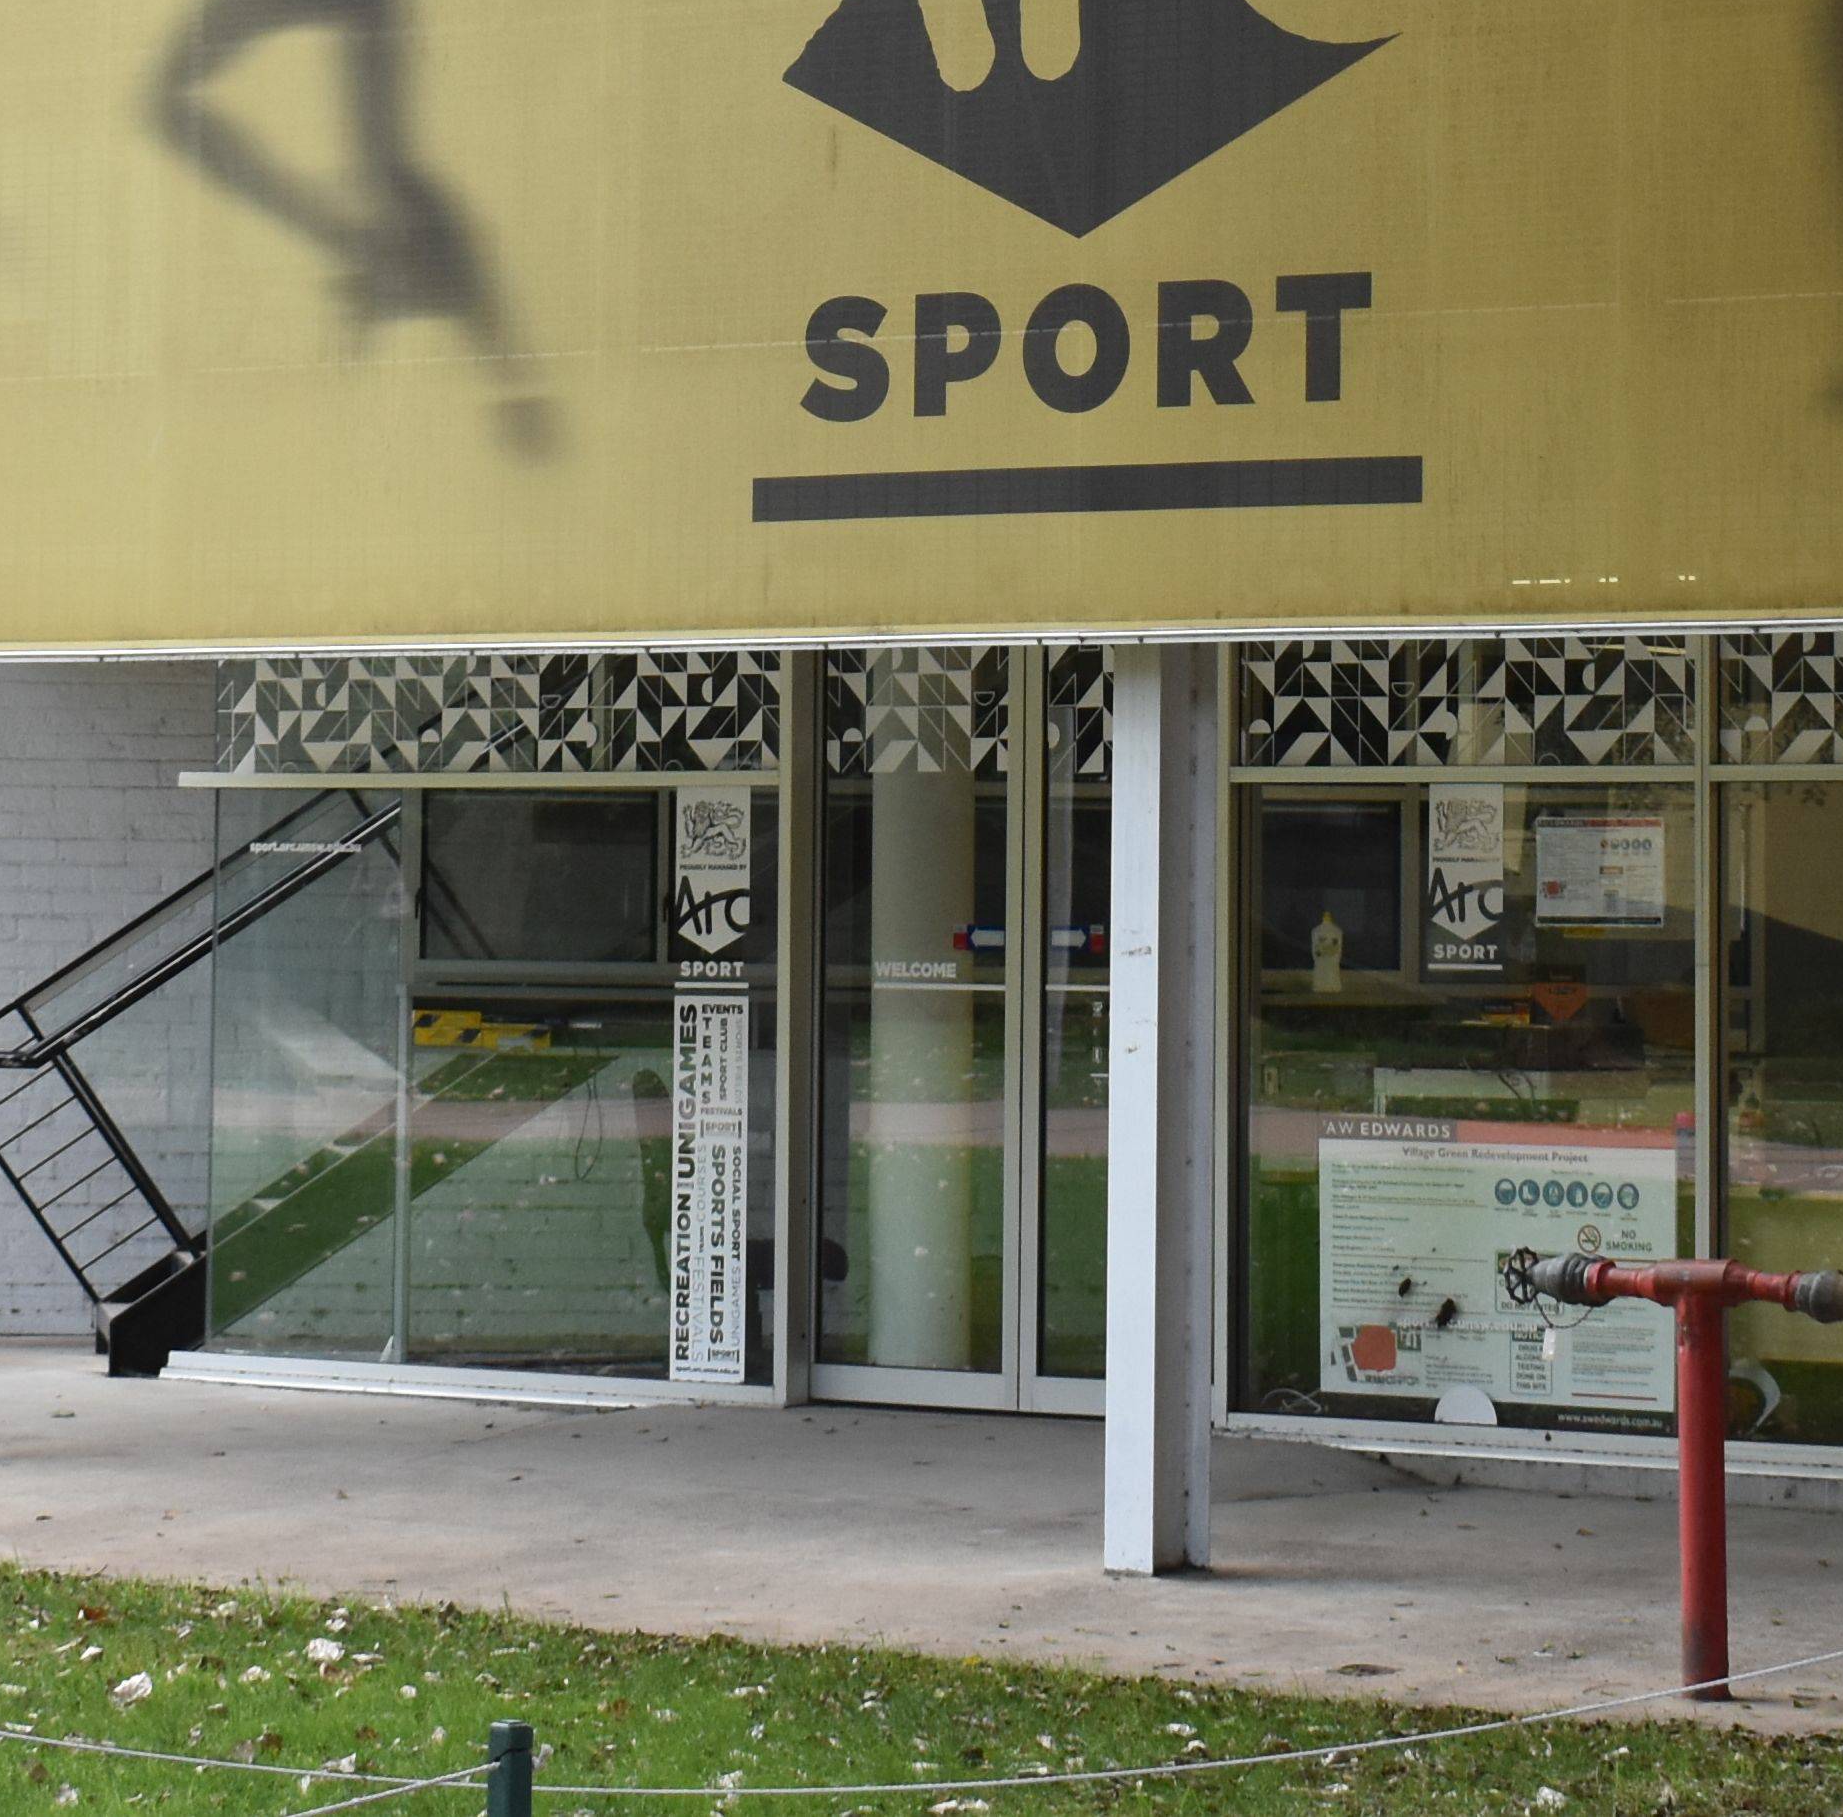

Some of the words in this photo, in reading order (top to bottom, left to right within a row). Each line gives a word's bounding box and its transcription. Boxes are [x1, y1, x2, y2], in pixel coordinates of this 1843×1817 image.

[799, 271, 1372, 422] SPORT
[676, 876, 749, 936] Arc
[1434, 944, 1497, 959] SPORT
[681, 961, 744, 977] SPORT
[875, 962, 956, 978] WELCOME
[702, 1004, 743, 1014] EVENTS
[678, 1004, 697, 1178] UNIGAMES
[1360, 1122, 1451, 1138] EDWARDS
[1402, 1146, 1435, 1159] Village
[1438, 1148, 1468, 1158] Green
[1471, 1149, 1548, 1162] Redevelopment
[1552, 1152, 1588, 1163] Project
[711, 1144, 726, 1248] SPORTS
[1622, 1230, 1636, 1239] NO
[1606, 1241, 1652, 1252] SMOKING
[676, 1194, 691, 1361] RECREATION
[709, 1254, 725, 1344] FIELDS
[1517, 1332, 1544, 1341] NOTIC
